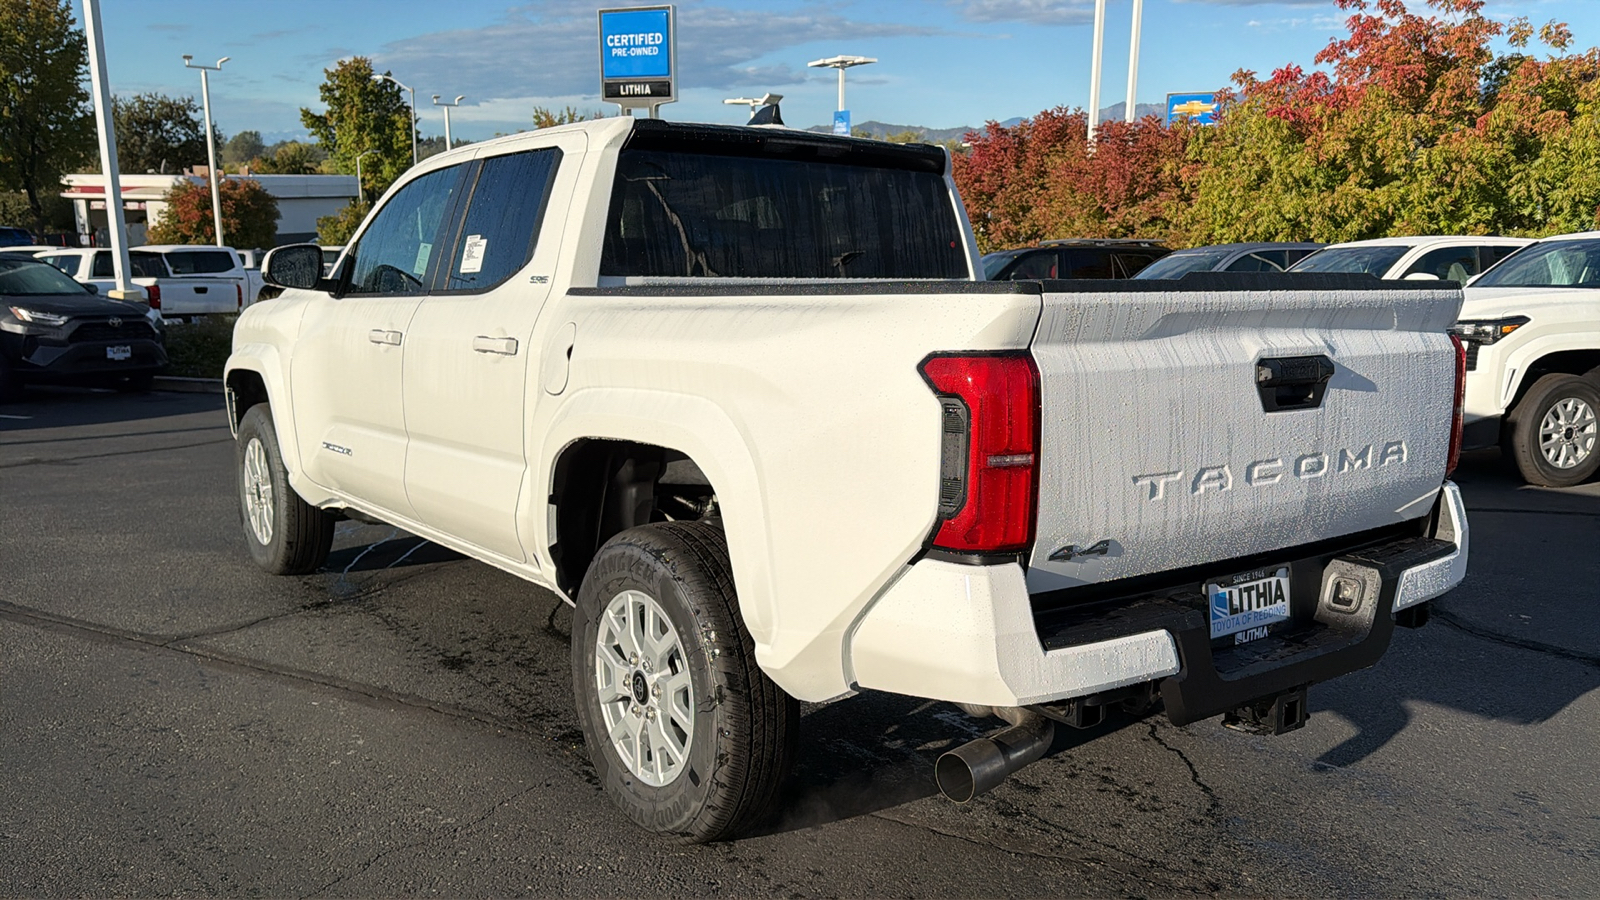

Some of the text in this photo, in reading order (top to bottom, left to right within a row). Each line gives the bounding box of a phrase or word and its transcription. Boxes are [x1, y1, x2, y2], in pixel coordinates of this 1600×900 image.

[606, 32, 663, 47] CERTIFIED
[611, 46, 659, 57] PRE-OWNED
[620, 84, 651, 95] LITHIA
[1132, 440, 1408, 502] TACOMA
[1232, 572, 1250, 584] SINCE
[1228, 578, 1286, 616] LITHIA
[1212, 604, 1287, 633] TOYOTA OF REDDING
[1242, 626, 1269, 643] LITHIA
